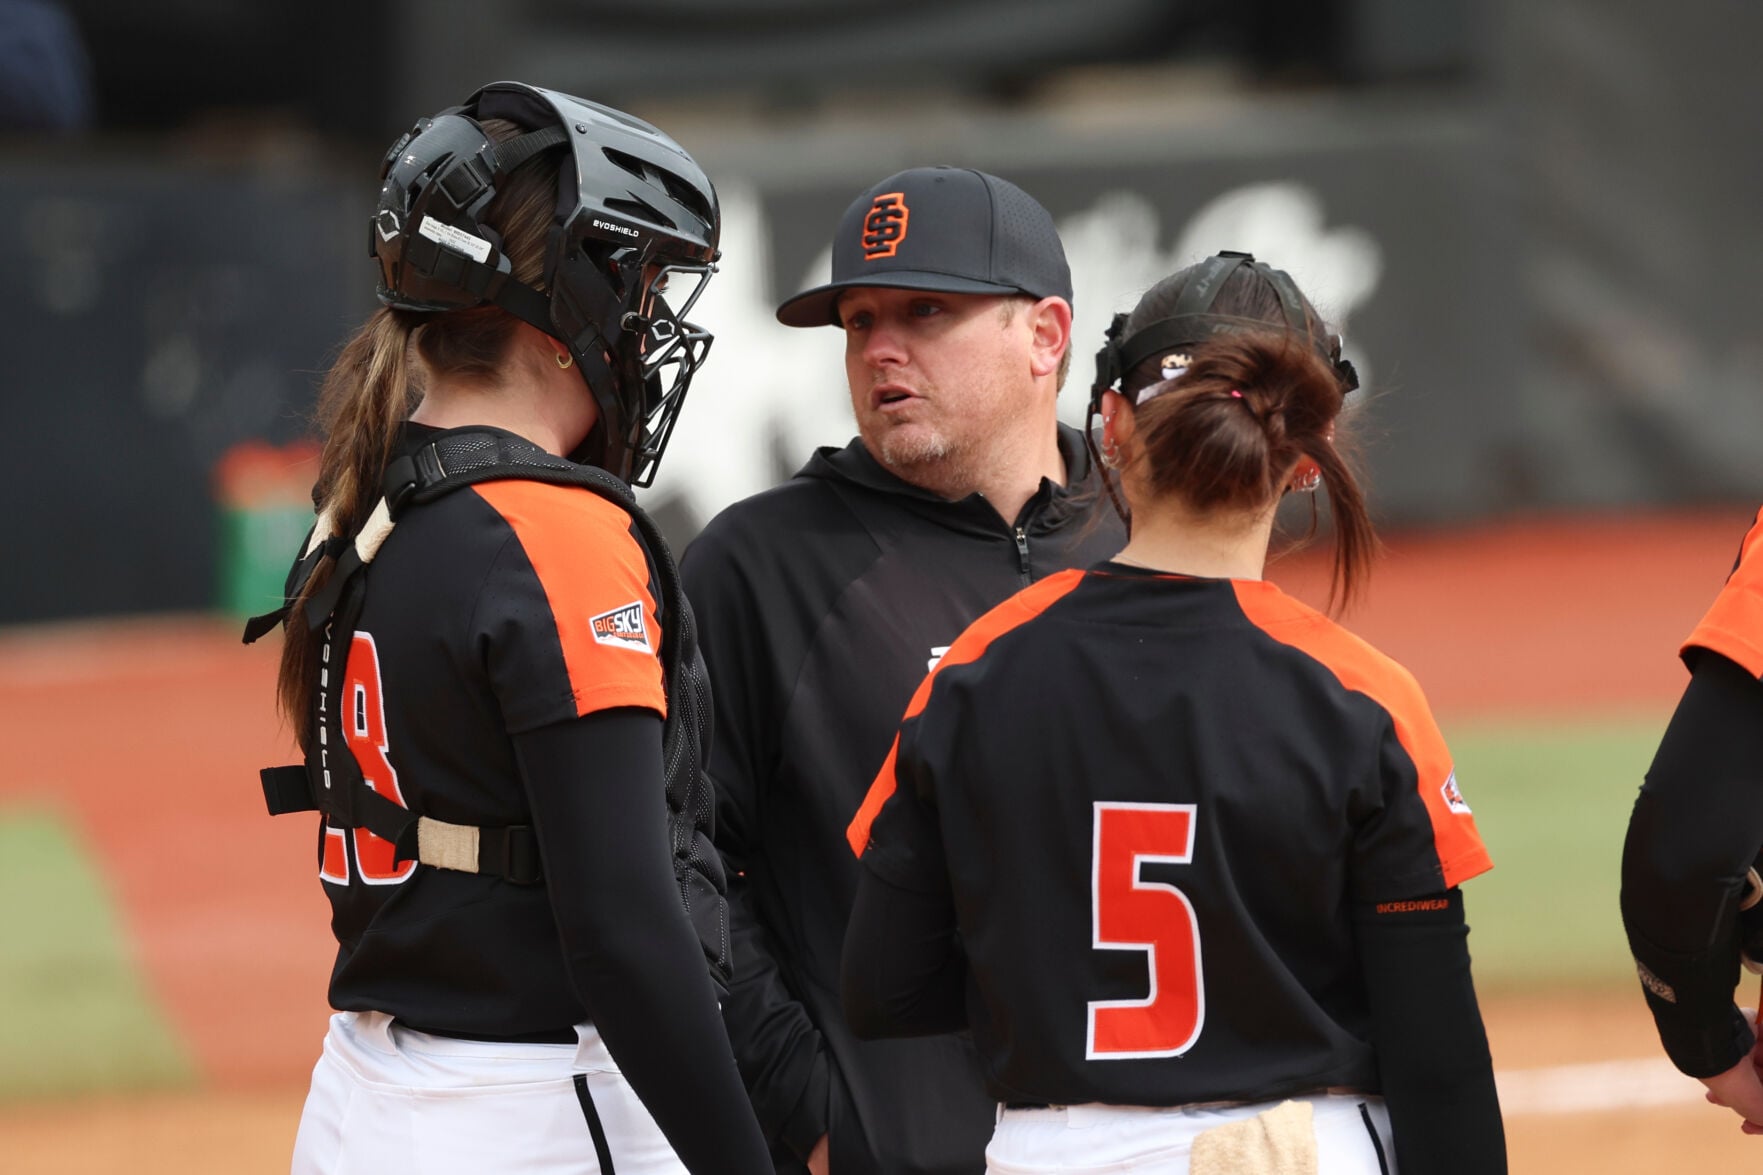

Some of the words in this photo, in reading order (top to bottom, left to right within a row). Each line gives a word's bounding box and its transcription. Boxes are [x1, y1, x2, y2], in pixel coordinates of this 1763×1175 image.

[593, 219, 640, 237] EVOSHIELD
[319, 611, 335, 790] VOSHIELD
[1085, 801, 1205, 1060] 5
[1376, 899, 1449, 914] INCREDIWEAR
